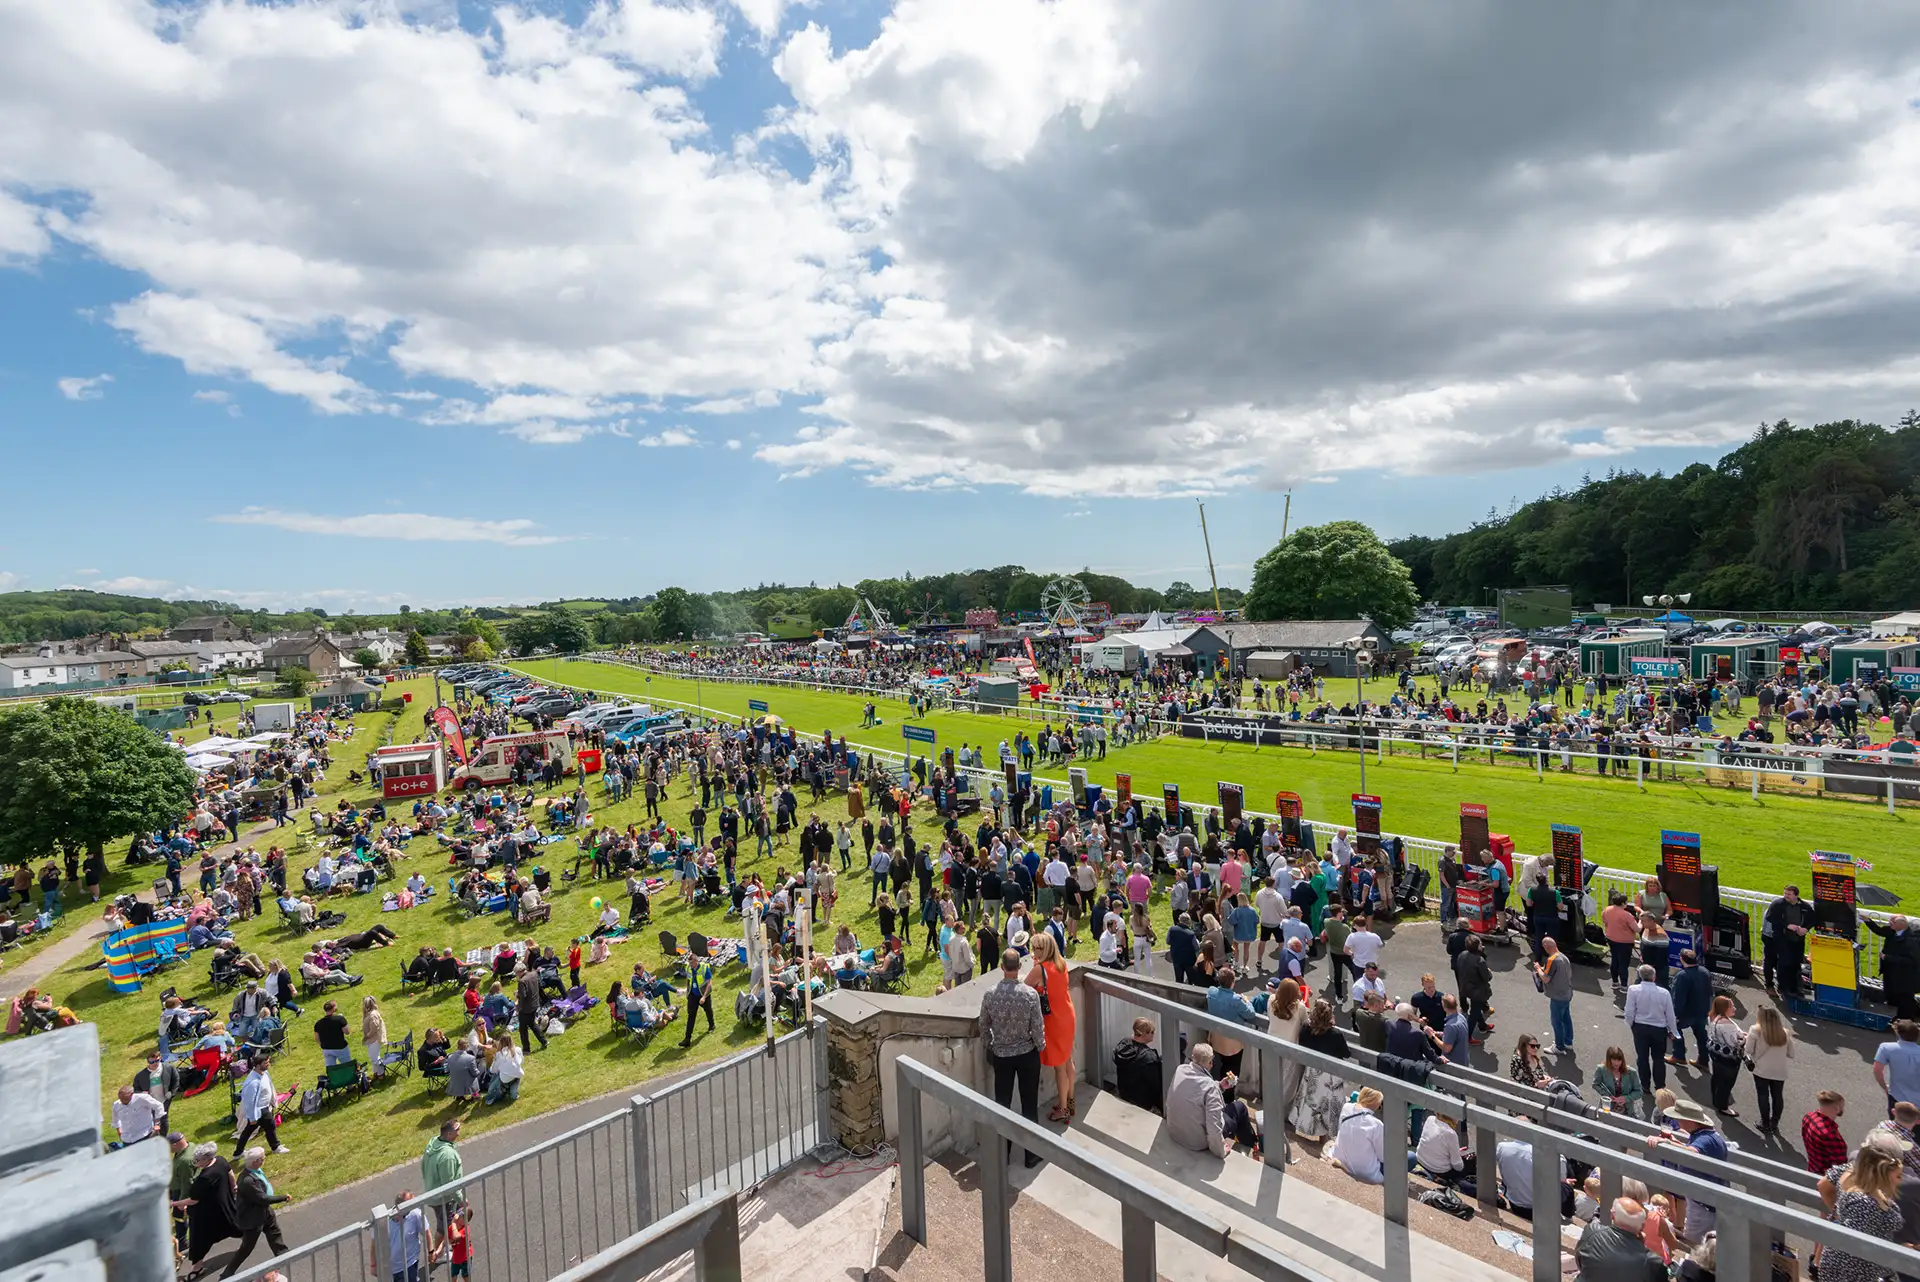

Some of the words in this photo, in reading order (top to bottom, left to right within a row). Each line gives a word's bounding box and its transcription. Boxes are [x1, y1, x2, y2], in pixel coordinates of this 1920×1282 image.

[1635, 662, 1674, 671] TOILETS
[1193, 717, 1243, 739] Racing
[1244, 721, 1266, 737] TV
[391, 780, 428, 791] tote
[1672, 937, 1690, 945] WARD
